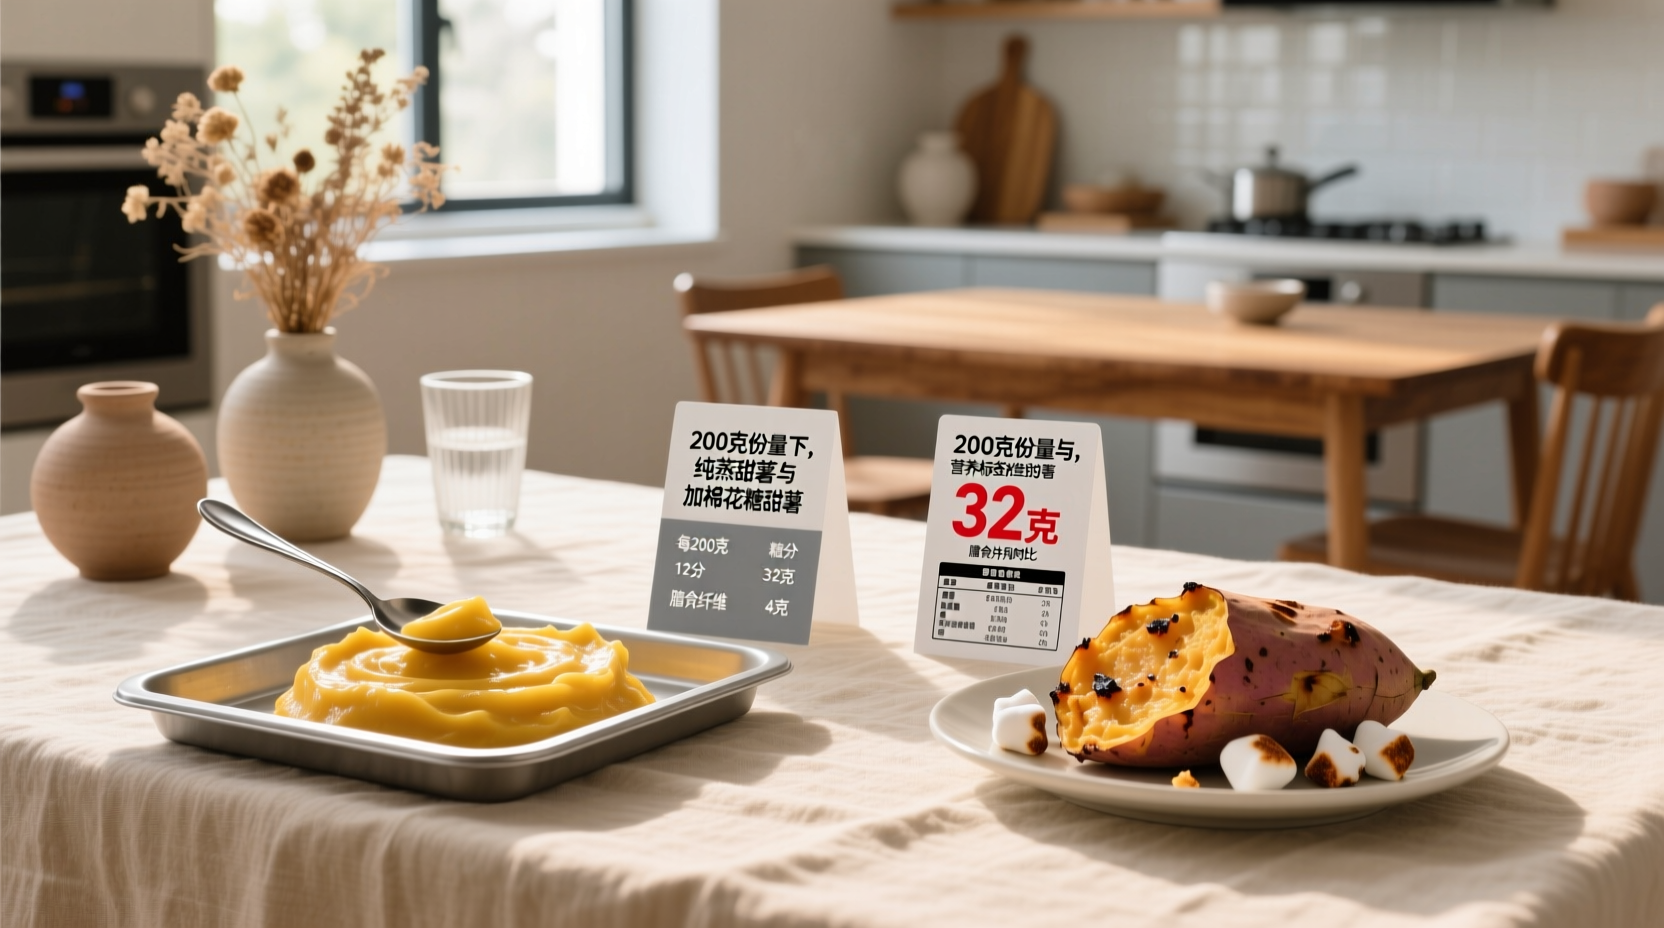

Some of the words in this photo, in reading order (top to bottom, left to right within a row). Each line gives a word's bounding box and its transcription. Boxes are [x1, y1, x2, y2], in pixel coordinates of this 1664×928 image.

[690, 430, 814, 461] 200克份量下，
[953, 434, 1081, 463] 200克份量与，
[693, 457, 797, 485] 纯蒸甜薯与
[951, 482, 1061, 545] 32克
[677, 533, 731, 555] 每200克
[675, 561, 707, 579] 12分
[762, 567, 797, 586] 32克
[764, 598, 791, 618] 4克
